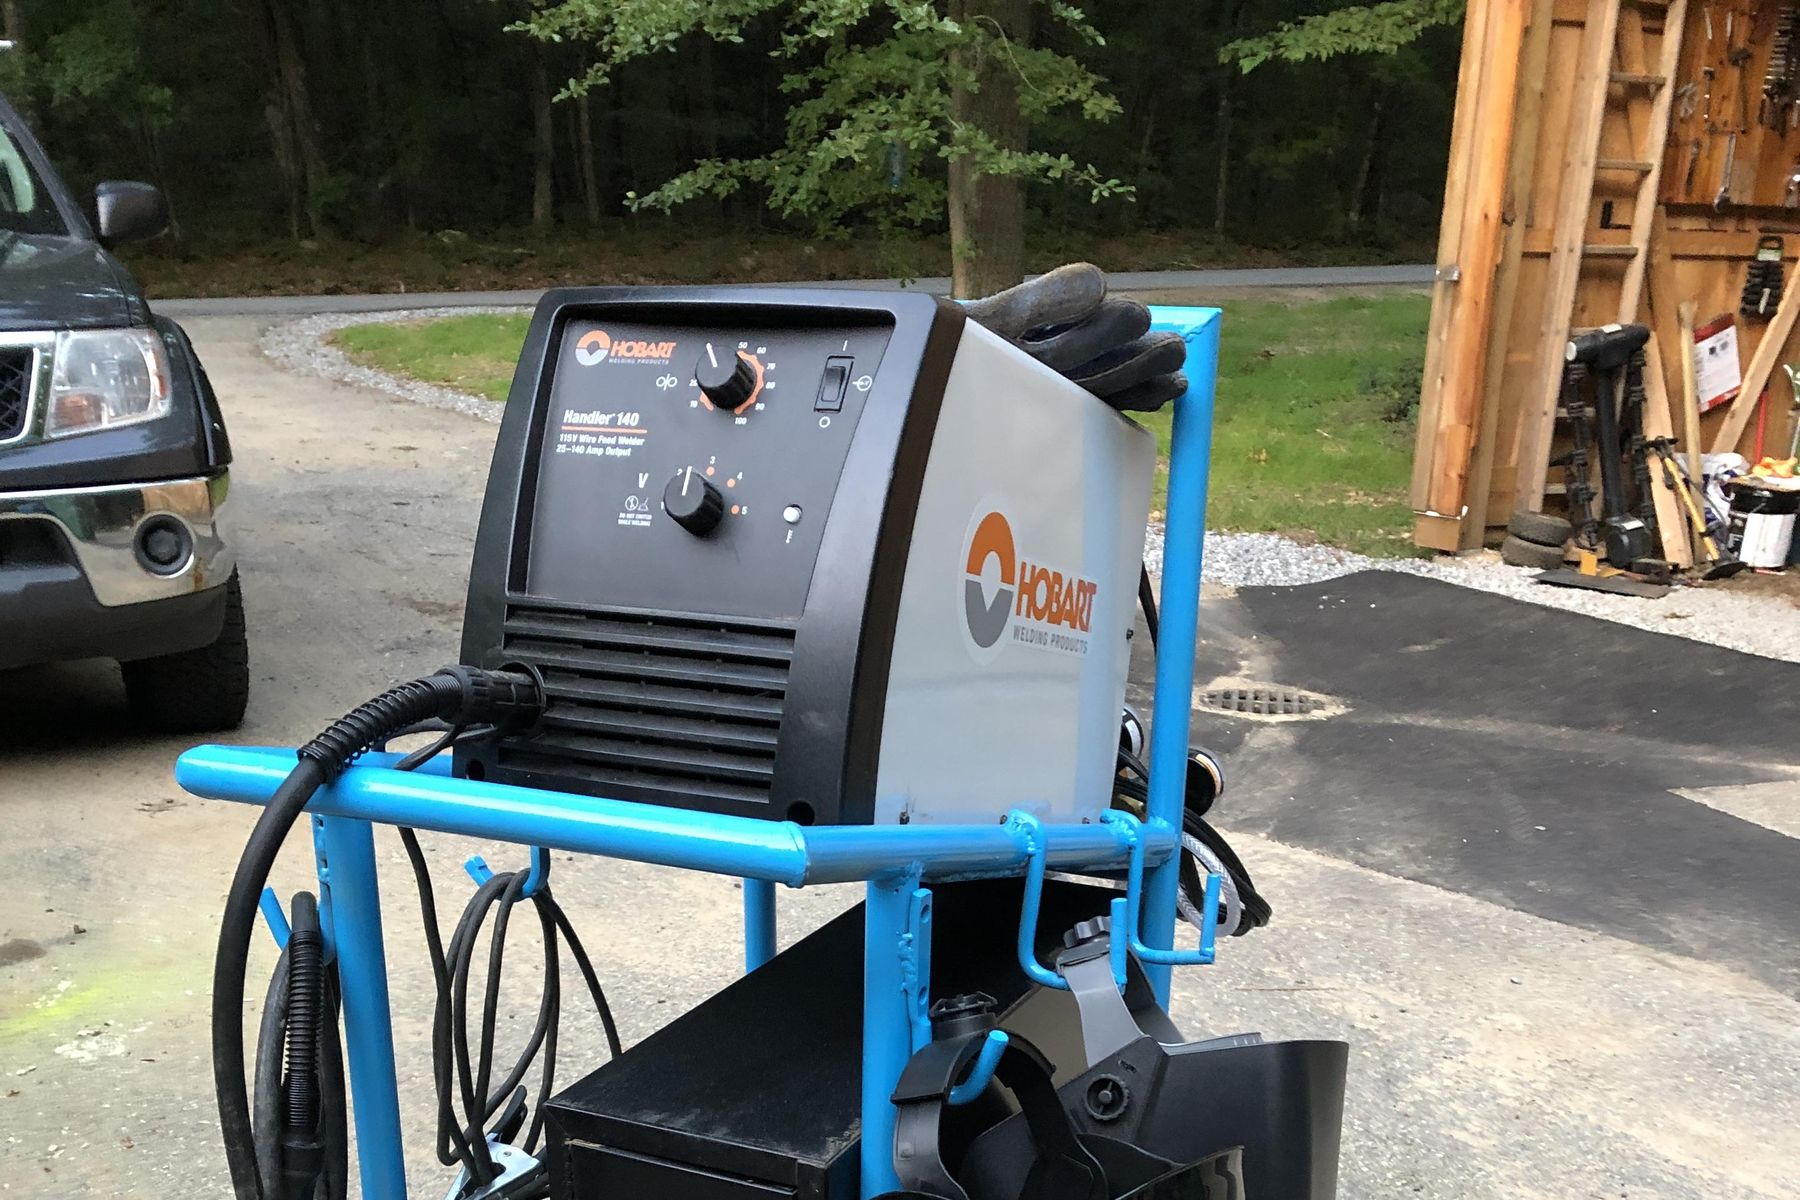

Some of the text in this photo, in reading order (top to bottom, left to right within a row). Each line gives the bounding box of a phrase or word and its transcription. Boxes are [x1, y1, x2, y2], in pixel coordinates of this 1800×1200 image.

[610, 341, 676, 358] HOBART
[616, 412, 640, 426] 140
[734, 417, 747, 425] 100
[560, 433, 578, 443] 115V
[579, 434, 596, 443] Wire
[597, 435, 617, 445] Feed
[586, 446, 604, 457] Amp
[605, 446, 632, 457] Output
[709, 456, 716, 464] 3
[638, 473, 649, 489] V
[737, 471, 743, 480] 4
[741, 506, 748, 515] 5
[1015, 561, 1097, 632] HOBART
[1013, 625, 1088, 654] WELDING PRODUCTS
